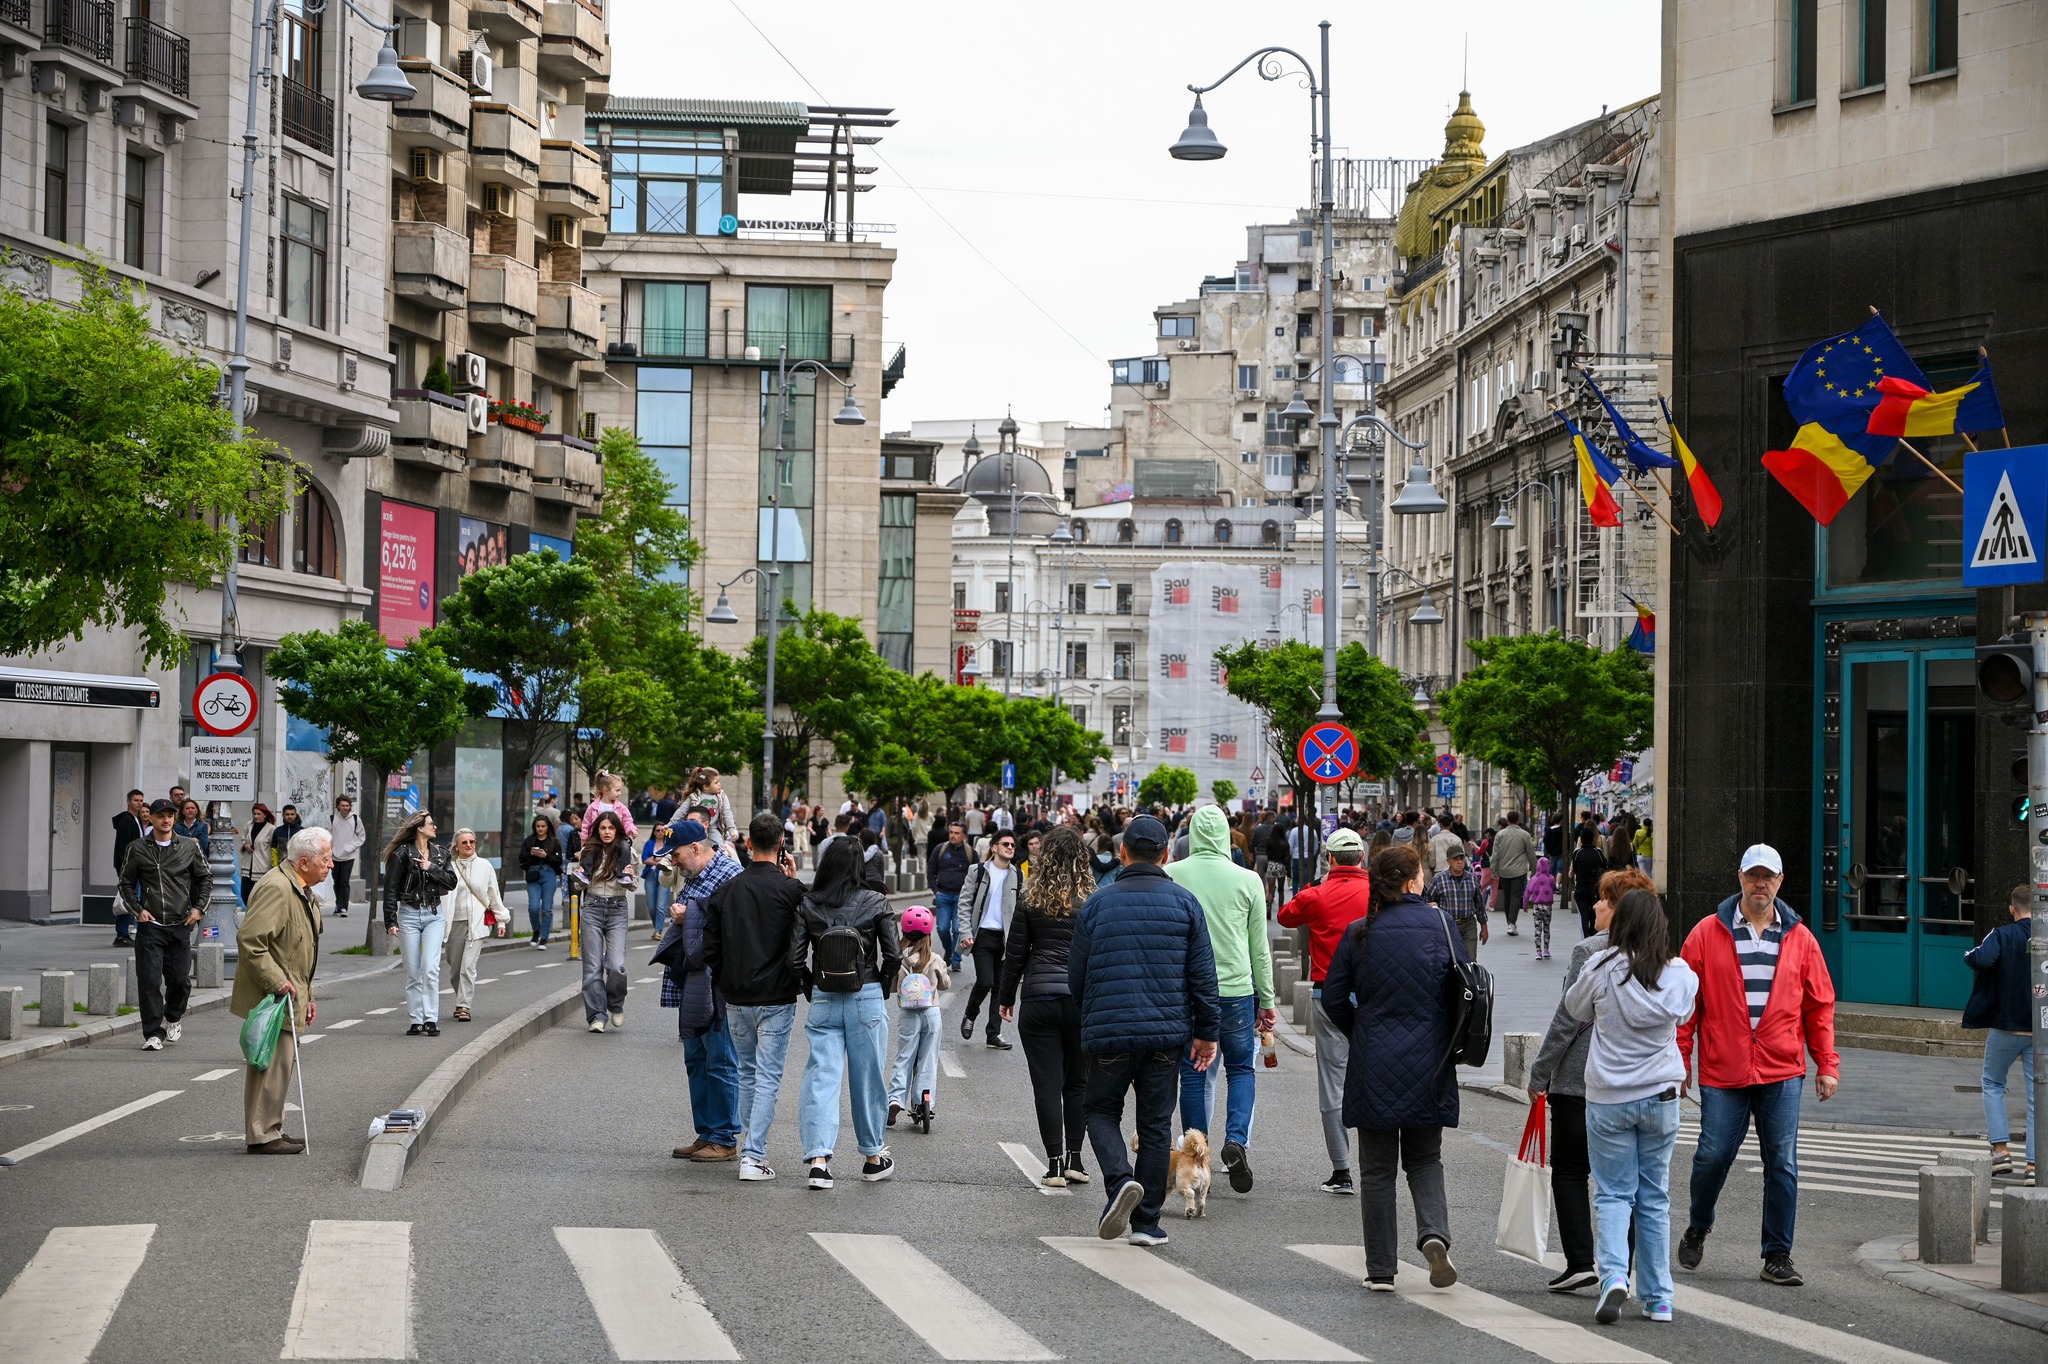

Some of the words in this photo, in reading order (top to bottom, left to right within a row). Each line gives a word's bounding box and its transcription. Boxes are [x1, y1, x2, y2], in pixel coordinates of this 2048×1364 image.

[382, 541, 417, 574] 6,25%
[15, 682, 51, 699] COLOSSEUM
[53, 686, 89, 703] RISTORANTE
[195, 757, 210, 766] ÎNTRE
[211, 759, 229, 767] ORELE
[221, 772, 248, 780] BICICLETE
